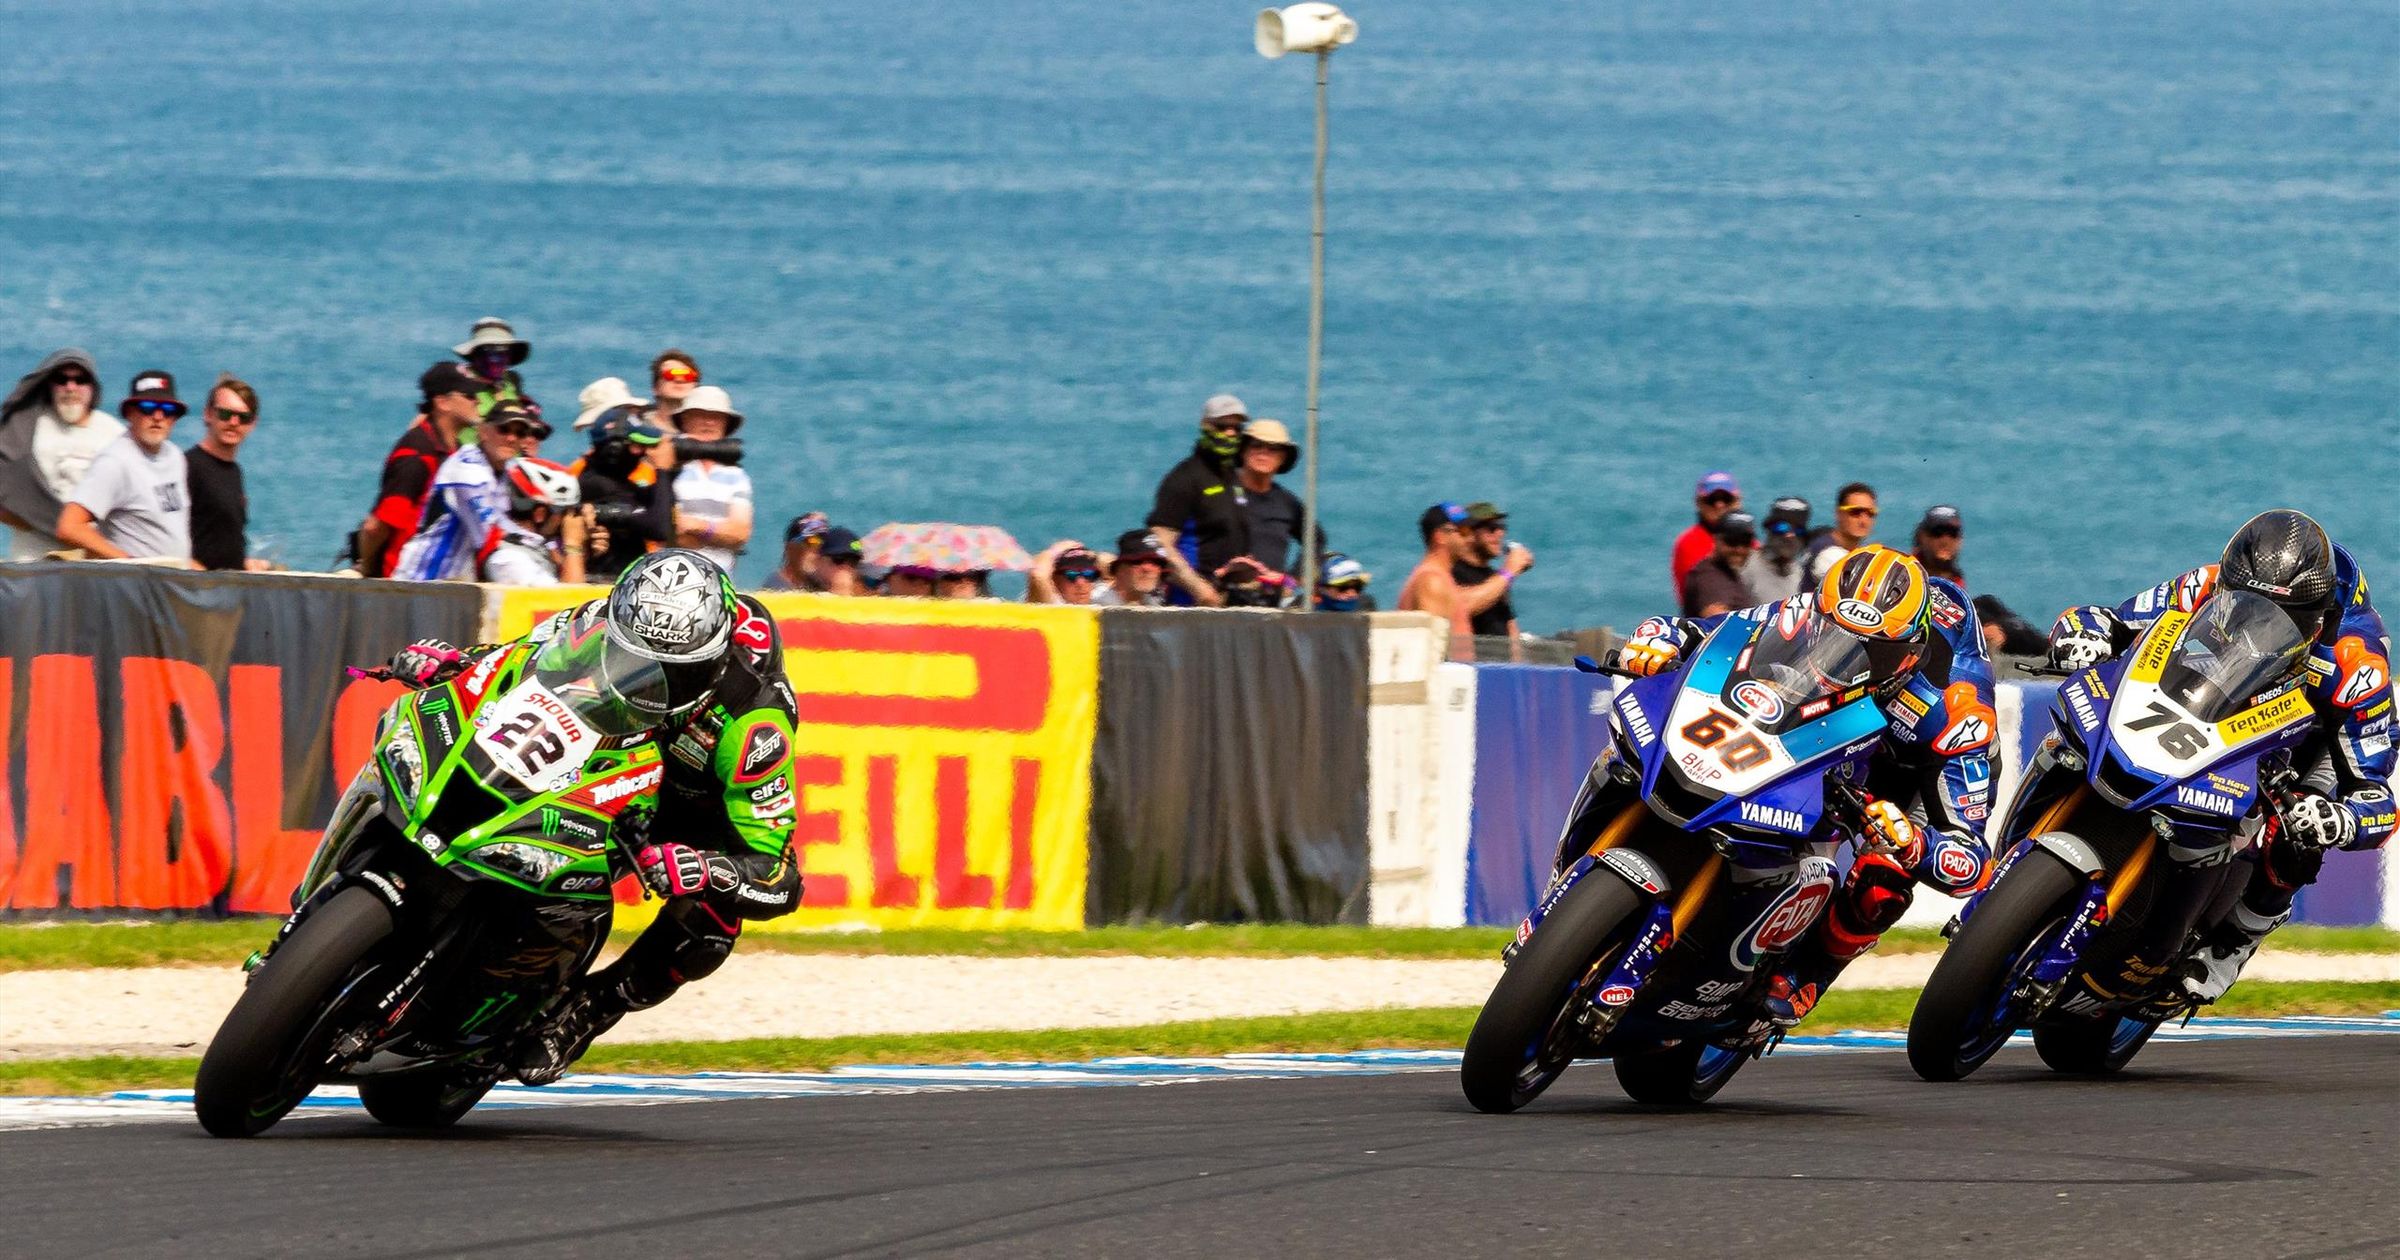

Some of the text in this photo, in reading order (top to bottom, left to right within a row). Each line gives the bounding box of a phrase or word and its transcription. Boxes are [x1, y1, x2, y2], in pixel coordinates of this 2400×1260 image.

[1840, 603, 1877, 622] Arai
[634, 624, 692, 643] SHARK
[1741, 688, 1776, 715] PATA
[1802, 700, 1830, 717] MOTUL
[2065, 681, 2100, 732] YAMAHA
[2257, 686, 2282, 704] ENEOS
[525, 693, 582, 743] SHOWA
[1618, 693, 1656, 747] YAMAHA
[1894, 702, 1918, 723] YAMAHA
[2227, 715, 2258, 735] Ten
[1681, 706, 1773, 775] 60
[1890, 720, 1918, 742] BMP
[2123, 700, 2210, 760] 76
[487, 712, 566, 777] 22
[744, 731, 782, 771] RST
[1682, 752, 1722, 780] BMP
[751, 781, 776, 801] elf
[2177, 784, 2234, 816] YAMAHA
[1740, 801, 1803, 832] YAMAHA
[1944, 851, 1970, 876] PATA
[2043, 836, 2083, 863] YAMAHA
[1604, 854, 1642, 882] FERODO
[1614, 850, 1653, 880] YAMAHA
[561, 877, 588, 891] elf
[738, 883, 789, 904] Kawasaki
[1543, 871, 1579, 917] PIRELLI
[1762, 894, 1826, 938] PATA
[2060, 900, 2097, 950] PIRELLI
[1623, 922, 1661, 970] PIRELLI
[1606, 991, 1629, 1002] HEL
[1696, 980, 1744, 997] BMP
